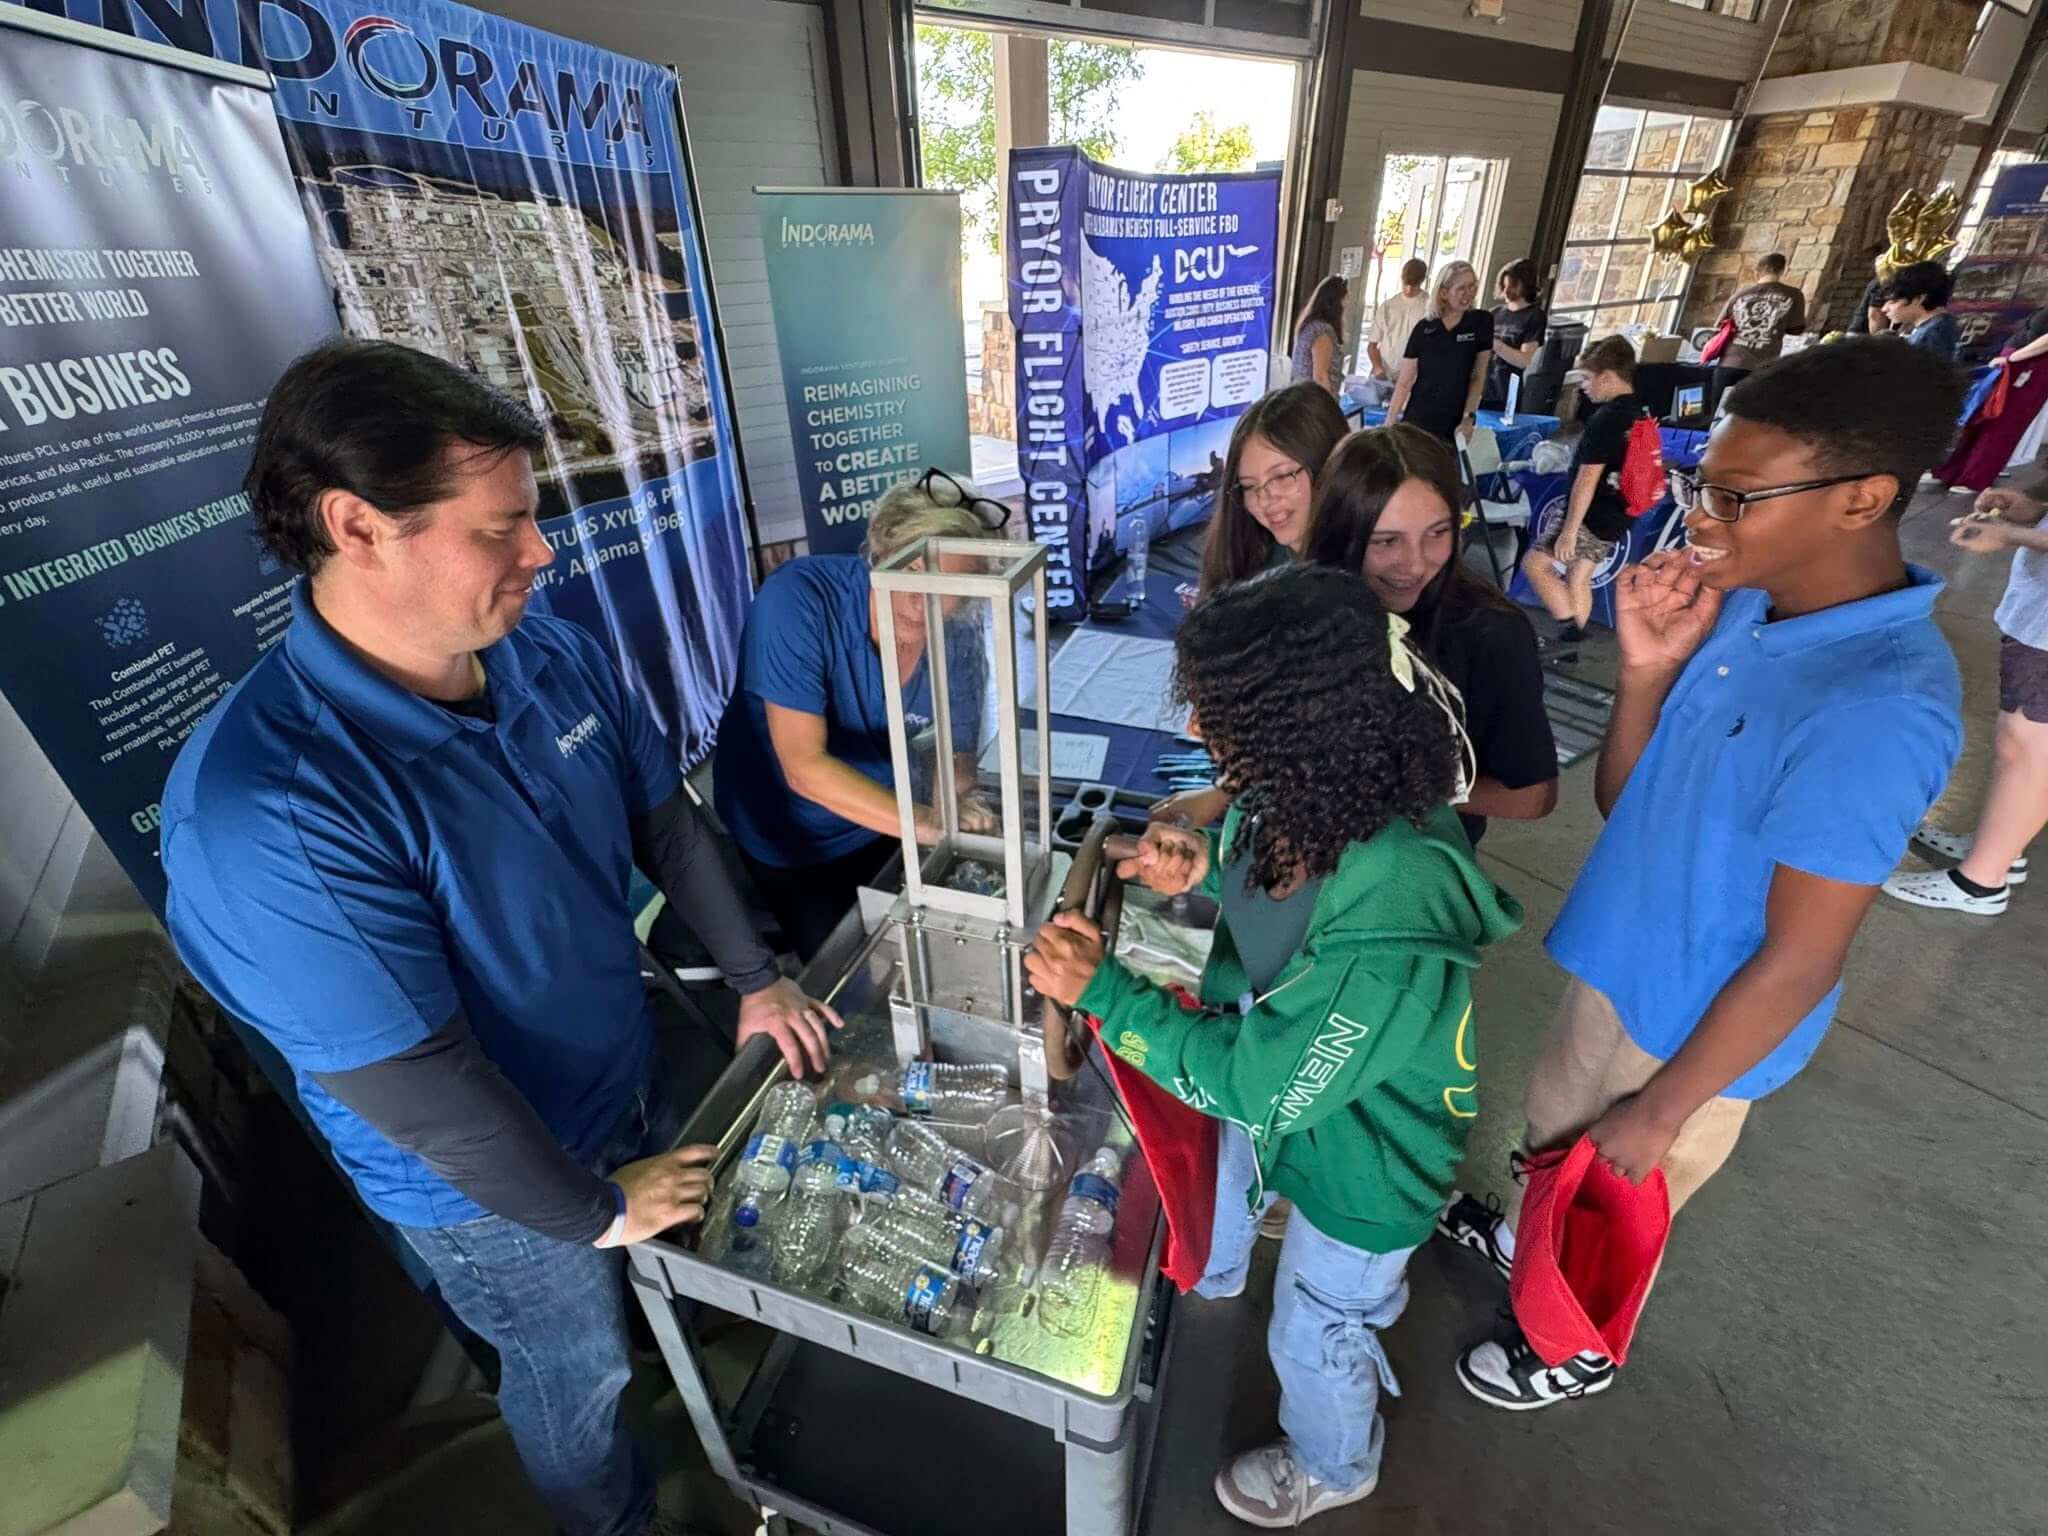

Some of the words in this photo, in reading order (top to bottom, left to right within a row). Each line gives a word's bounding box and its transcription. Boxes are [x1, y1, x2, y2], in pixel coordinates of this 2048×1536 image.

[1117, 180, 1158, 214] FLIGHT
[1160, 182, 1217, 214] CENTER
[782, 216, 874, 243] INDORAMA
[1017, 169, 1063, 314] PRYOR
[1155, 215, 1217, 237] FULL-SERVICE
[1219, 214, 1239, 234] FBO
[0, 249, 106, 281] HEMISTRY
[102, 250, 200, 279] TOGETHER
[1175, 245, 1225, 284] DCU
[0, 291, 83, 326] BETTER
[77, 289, 149, 320] WORLD
[0, 347, 191, 426] BUSINESS
[804, 374, 921, 403] REIMAGINING
[1023, 332, 1067, 467] FLIGHT
[807, 400, 906, 426] CHEMISTRY
[810, 423, 903, 450] TOGETHER
[36, 465, 57, 481] and
[58, 462, 80, 475] Asia
[114, 449, 134, 460] The
[815, 460, 833, 473] TO
[836, 443, 921, 473] CREATE
[8, 490, 56, 512] produce
[819, 481, 837, 502] A
[24, 514, 49, 529] day.
[4, 539, 128, 600] INTEGRATED
[125, 511, 201, 557] BUSINESS
[198, 491, 252, 528] SEGMENT
[1029, 481, 1075, 608] CENTER
[111, 652, 159, 682] Combined
[157, 642, 177, 658] PET
[89, 697, 113, 710] The
[112, 672, 157, 701] Combined
[155, 662, 174, 678] PET
[99, 701, 141, 727] includes
[194, 658, 211, 674] PET
[100, 747, 122, 763] raw
